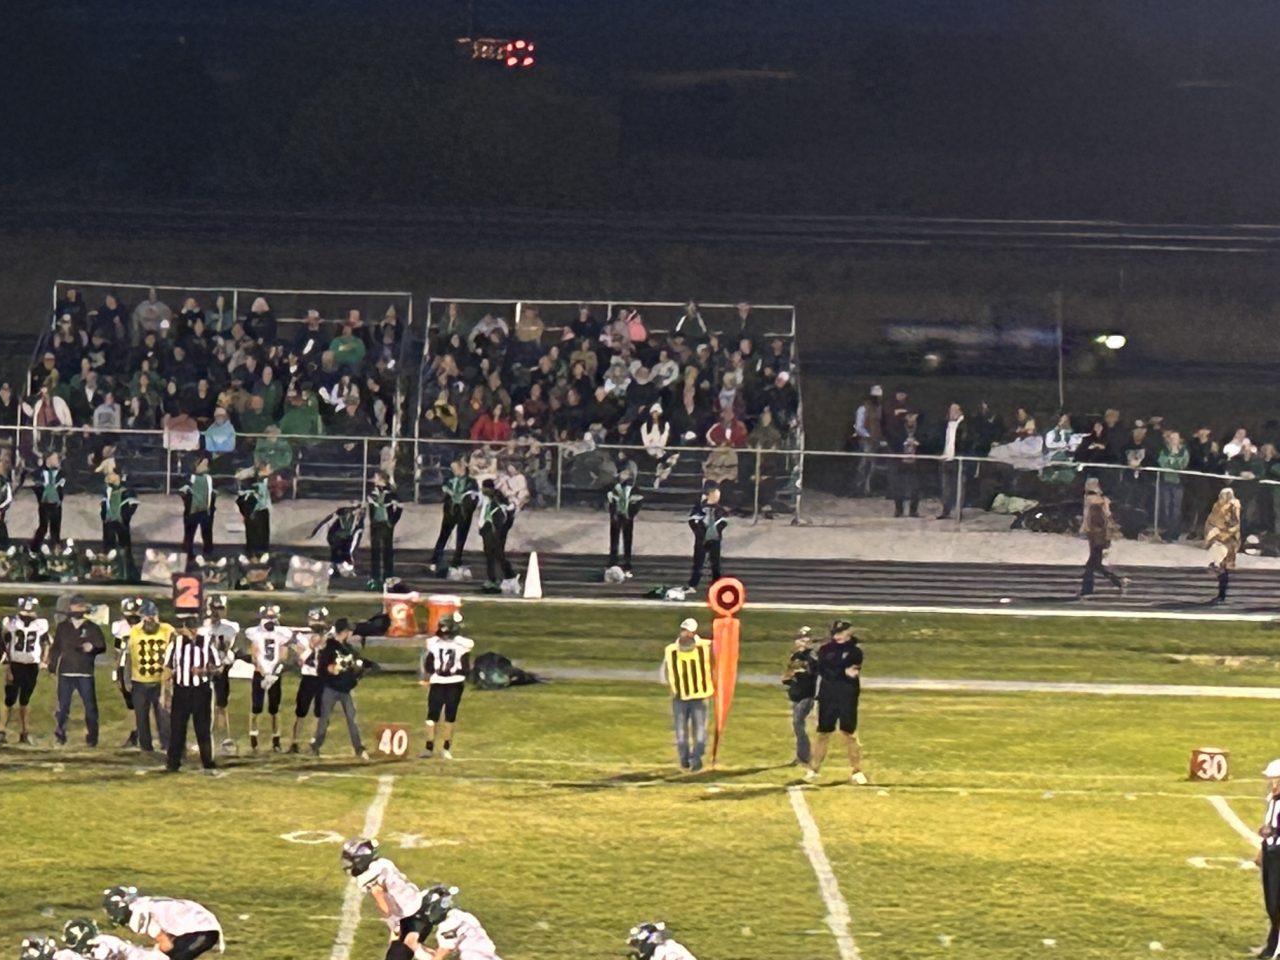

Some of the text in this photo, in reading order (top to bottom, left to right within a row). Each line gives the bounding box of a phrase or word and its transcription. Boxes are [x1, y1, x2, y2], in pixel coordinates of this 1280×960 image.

[176, 577, 200, 608] 2
[379, 719, 409, 756] 40
[1196, 753, 1228, 781] 30
